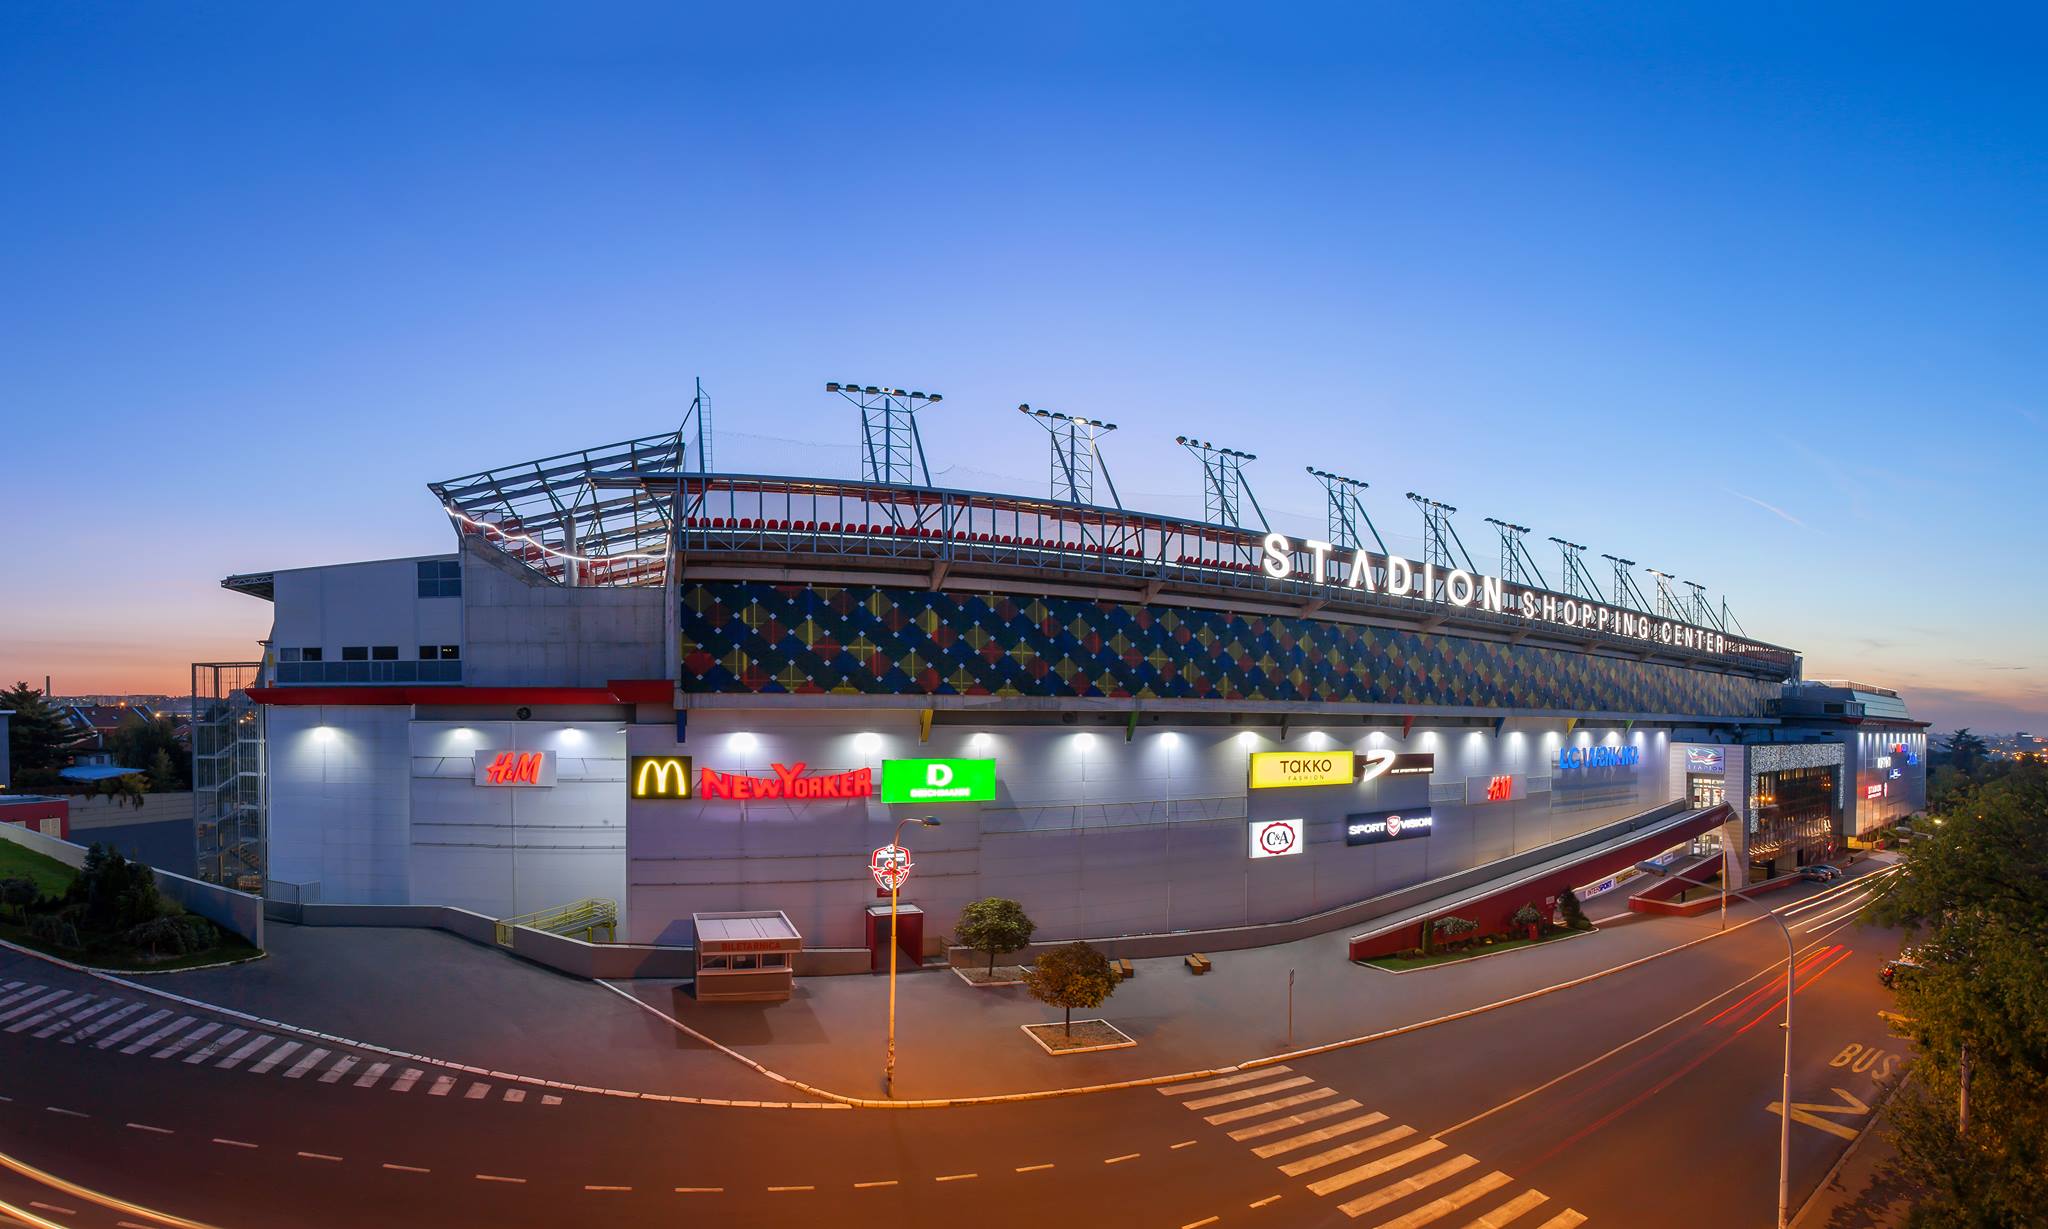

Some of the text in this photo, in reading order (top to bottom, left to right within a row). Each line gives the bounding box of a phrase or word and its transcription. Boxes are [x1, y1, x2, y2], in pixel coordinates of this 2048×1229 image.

[1263, 533, 1724, 654] STADION SHOPPING CENTER
[486, 752, 543, 784] H&M
[1287, 774, 1325, 782] FASHION
[1266, 831, 1289, 846] C&A
[1349, 816, 1433, 836] SPORT VISION
[1828, 1042, 1901, 1079] BUS
